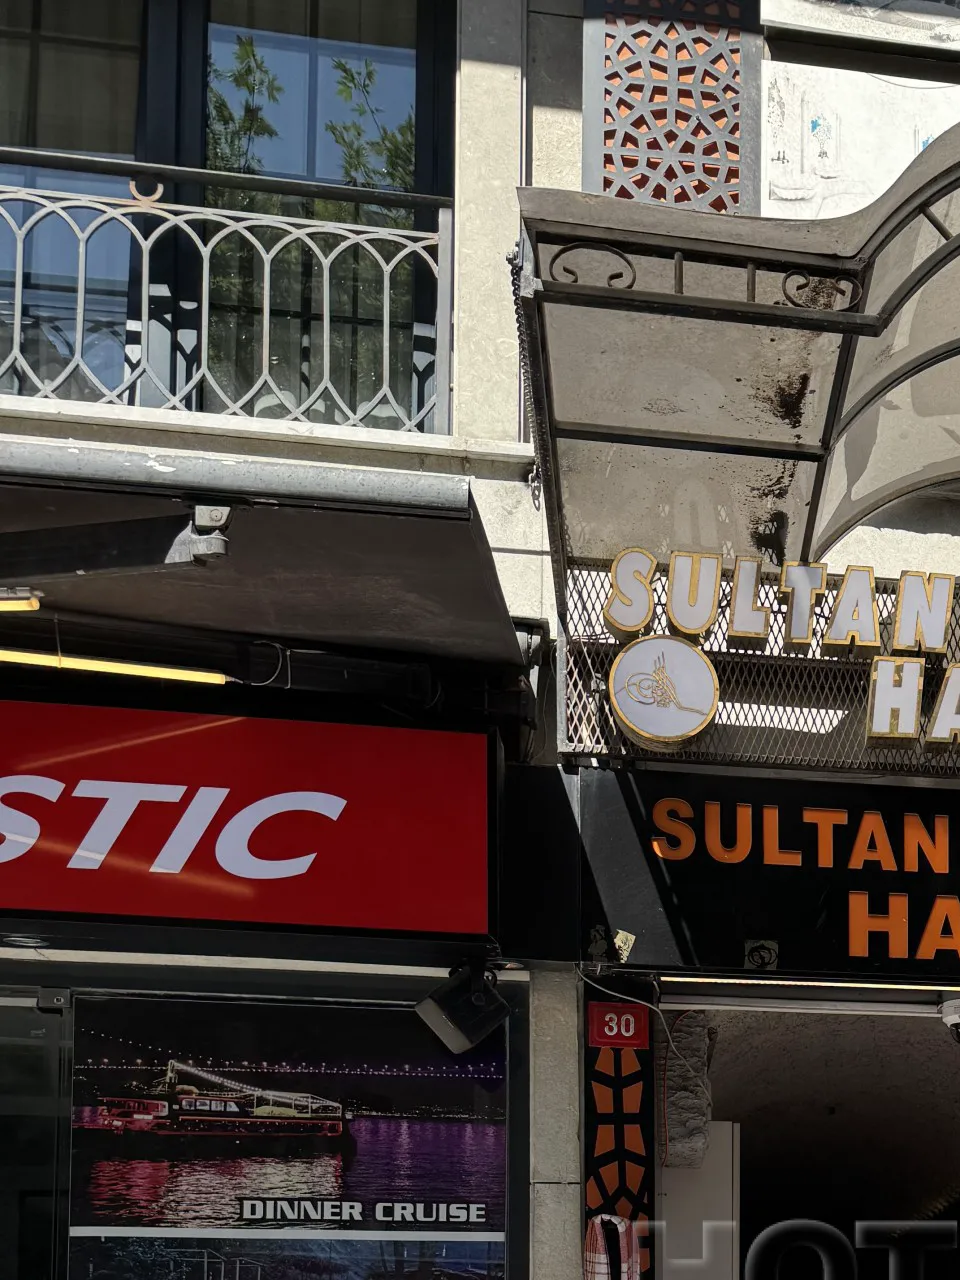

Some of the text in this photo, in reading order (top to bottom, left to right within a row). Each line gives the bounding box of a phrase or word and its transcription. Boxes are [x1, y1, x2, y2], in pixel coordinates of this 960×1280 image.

[603, 547, 955, 654] SULTAN
[0, 774, 348, 880] STIC
[651, 798, 950, 874] SULTAN
[604, 1013, 635, 1037] 30
[242, 1200, 487, 1223] DINNER CRUISE
